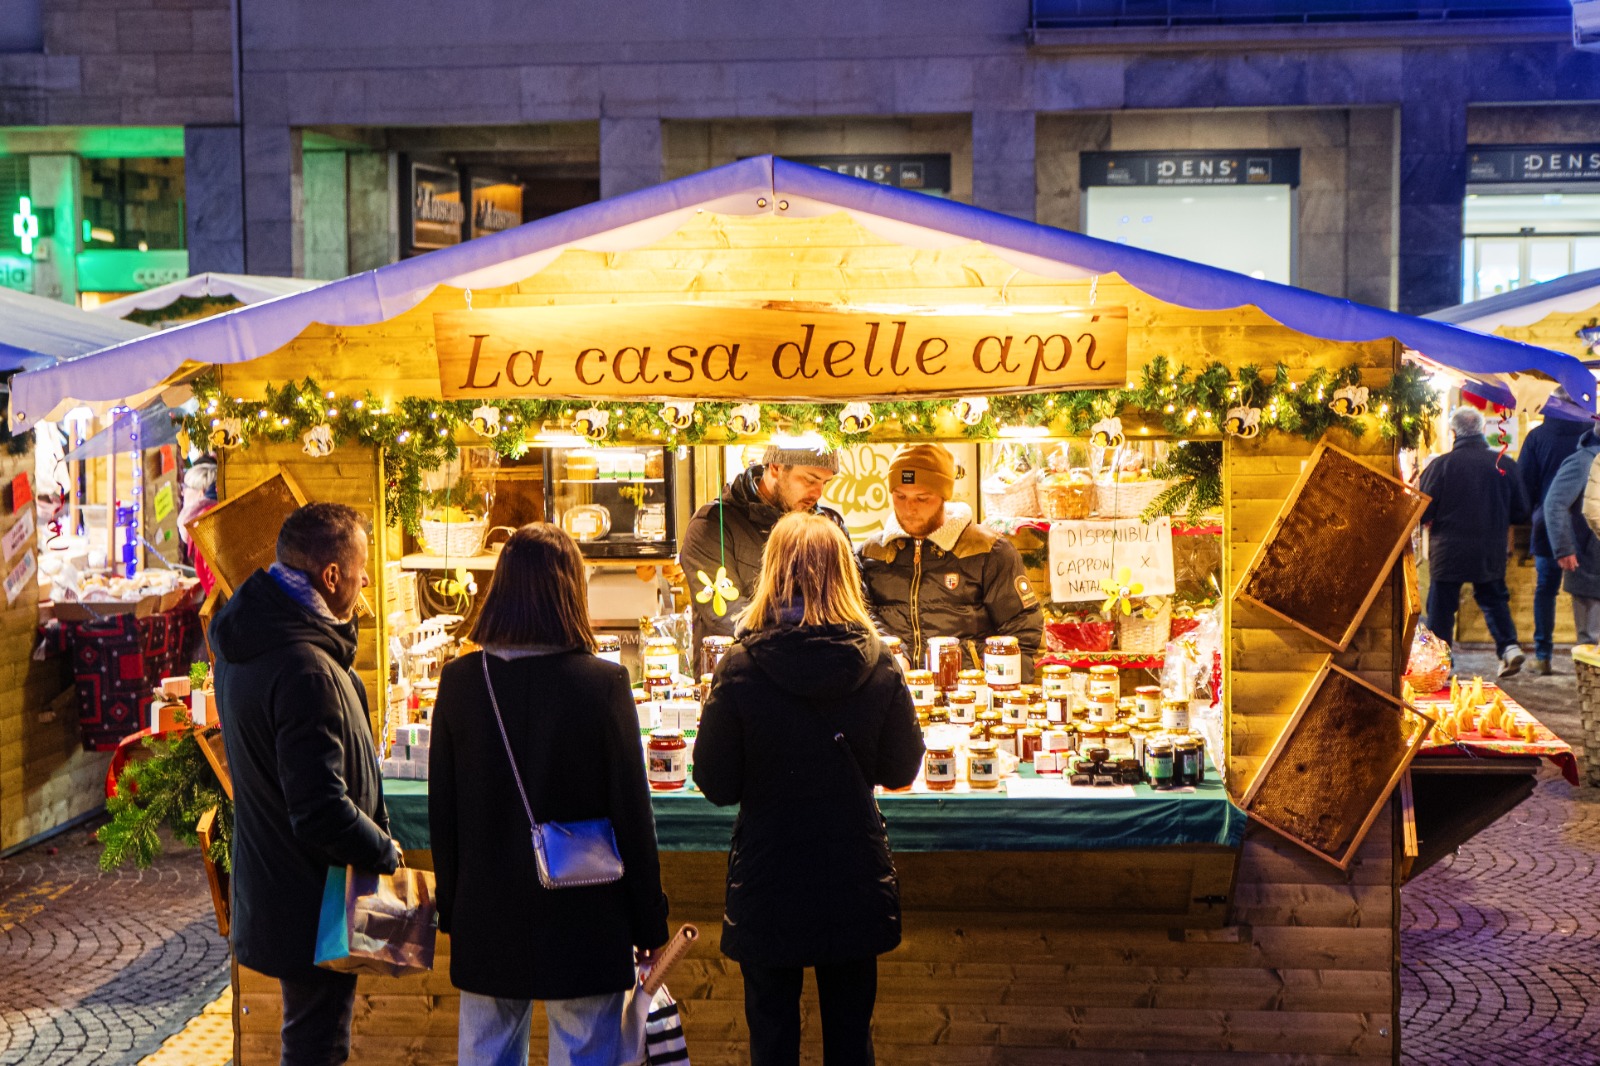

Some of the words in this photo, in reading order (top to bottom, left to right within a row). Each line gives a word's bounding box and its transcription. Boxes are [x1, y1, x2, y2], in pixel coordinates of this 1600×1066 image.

[459, 334, 552, 389] La
[575, 344, 748, 385] casa
[772, 321, 948, 380] delle
[972, 315, 1106, 386] api
[1067, 525, 1160, 547] DISPONIBILI
[1069, 580, 1103, 595] NATAL
